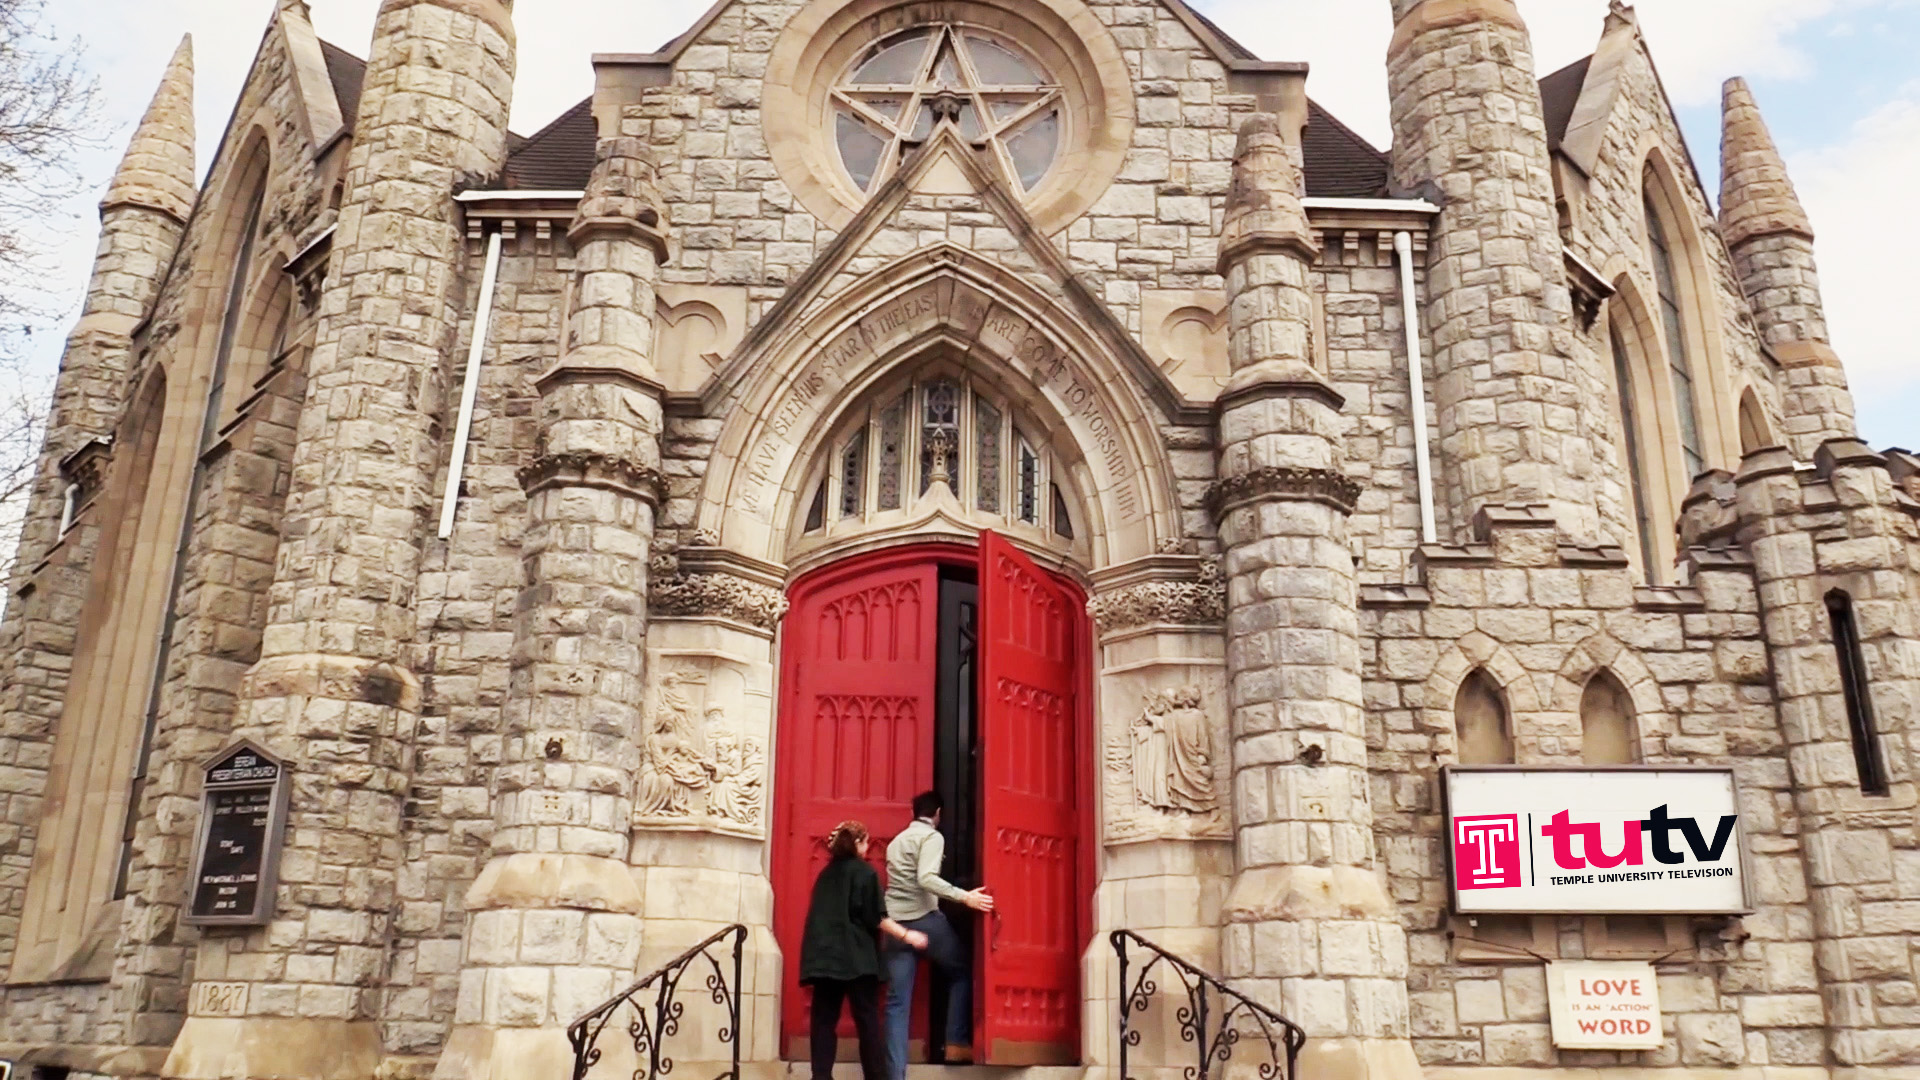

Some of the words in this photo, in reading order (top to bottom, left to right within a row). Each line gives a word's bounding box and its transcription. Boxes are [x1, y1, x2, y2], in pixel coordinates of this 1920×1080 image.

[748, 439, 780, 488] HAVE
[774, 391, 808, 437] SEEN
[799, 371, 826, 401] HIS
[821, 337, 861, 377] STAR
[878, 308, 905, 335] THE
[986, 317, 1020, 342] ARE
[1065, 378, 1086, 404] TO
[1082, 402, 1126, 477] WORSHIP
[1115, 485, 1136, 520] HIM
[1541, 803, 1738, 870] tutv
[1550, 874, 1594, 886] TEMPLE
[1598, 870, 1664, 883] UNIVERSITY
[1667, 867, 1733, 880] TELEVISION
[199, 984, 246, 1013] 1887
[1580, 979, 1641, 996] LOVE
[1571, 1003, 1581, 1011] IS
[1585, 1003, 1601, 1011] AN
[1577, 1019, 1651, 1035] WORD
